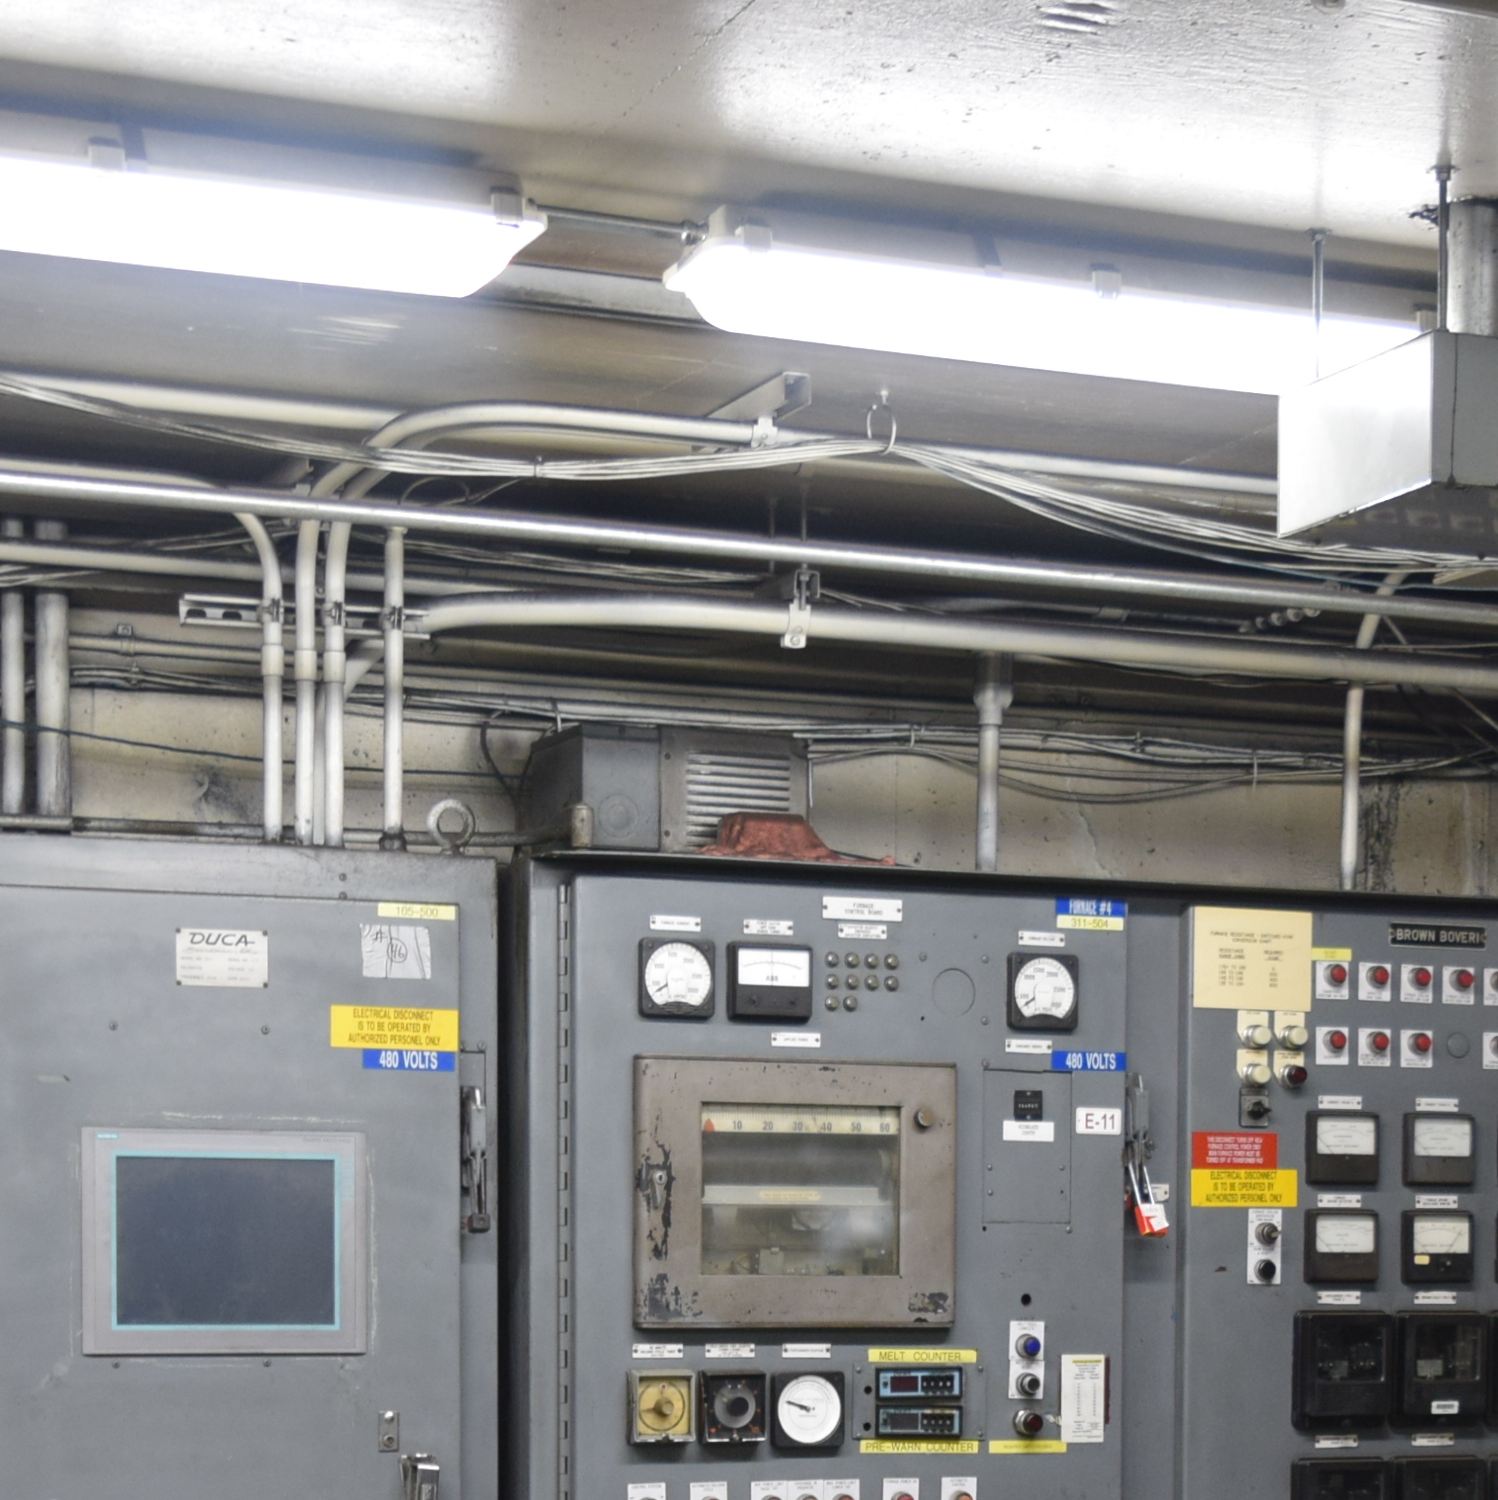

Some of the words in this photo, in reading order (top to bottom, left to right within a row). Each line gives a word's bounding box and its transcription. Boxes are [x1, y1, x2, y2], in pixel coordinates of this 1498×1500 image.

[397, 906, 438, 917] 105-500
[1069, 901, 1097, 915] FURNACE
[1100, 902, 1111, 915] #4
[1072, 918, 1109, 928] 311-504
[189, 932, 255, 946] DUCA
[1396, 928, 1435, 941] BROWN
[1440, 930, 1480, 944] BOVERI
[353, 1008, 391, 1019] ELECTRICAL
[394, 1010, 433, 1021] DISCONNECT
[358, 1021, 363, 1030] IS
[367, 1022, 375, 1031] TO
[377, 1022, 385, 1031] BE
[388, 1022, 420, 1032] OPERATED
[423, 1024, 431, 1033] BY
[349, 1034, 388, 1044] AUTHORIZED
[390, 1035, 422, 1045] PERSONEL
[426, 1036, 440, 1045] ONLY
[379, 1051, 399, 1068] 480
[403, 1051, 438, 1069] VOLTS
[1066, 1053, 1082, 1069] 480
[1086, 1053, 1116, 1069] VOLTS
[733, 1121, 742, 1130] 10
[763, 1121, 773, 1131] 20
[792, 1122, 803, 1131] 30
[821, 1122, 832, 1131] 40
[1085, 1113, 1115, 1130] E-11
[851, 1123, 861, 1132] 50
[880, 1123, 890, 1132] 60
[1211, 1171, 1242, 1180] ELECTRICAL
[1244, 1171, 1277, 1180] DISCONNECT
[1221, 1183, 1227, 1191] TO
[1230, 1183, 1236, 1191] BE
[1238, 1183, 1265, 1191] OPERATED
[1268, 1183, 1274, 1191] BY
[1206, 1194, 1238, 1202] AUTHORIZED
[1270, 1194, 1282, 1203] ONLY
[879, 1352, 905, 1360] MELT
[913, 1352, 961, 1361] COUNTER
[865, 1442, 920, 1451] PRE-WARN
[926, 1443, 973, 1451] COUNTER
